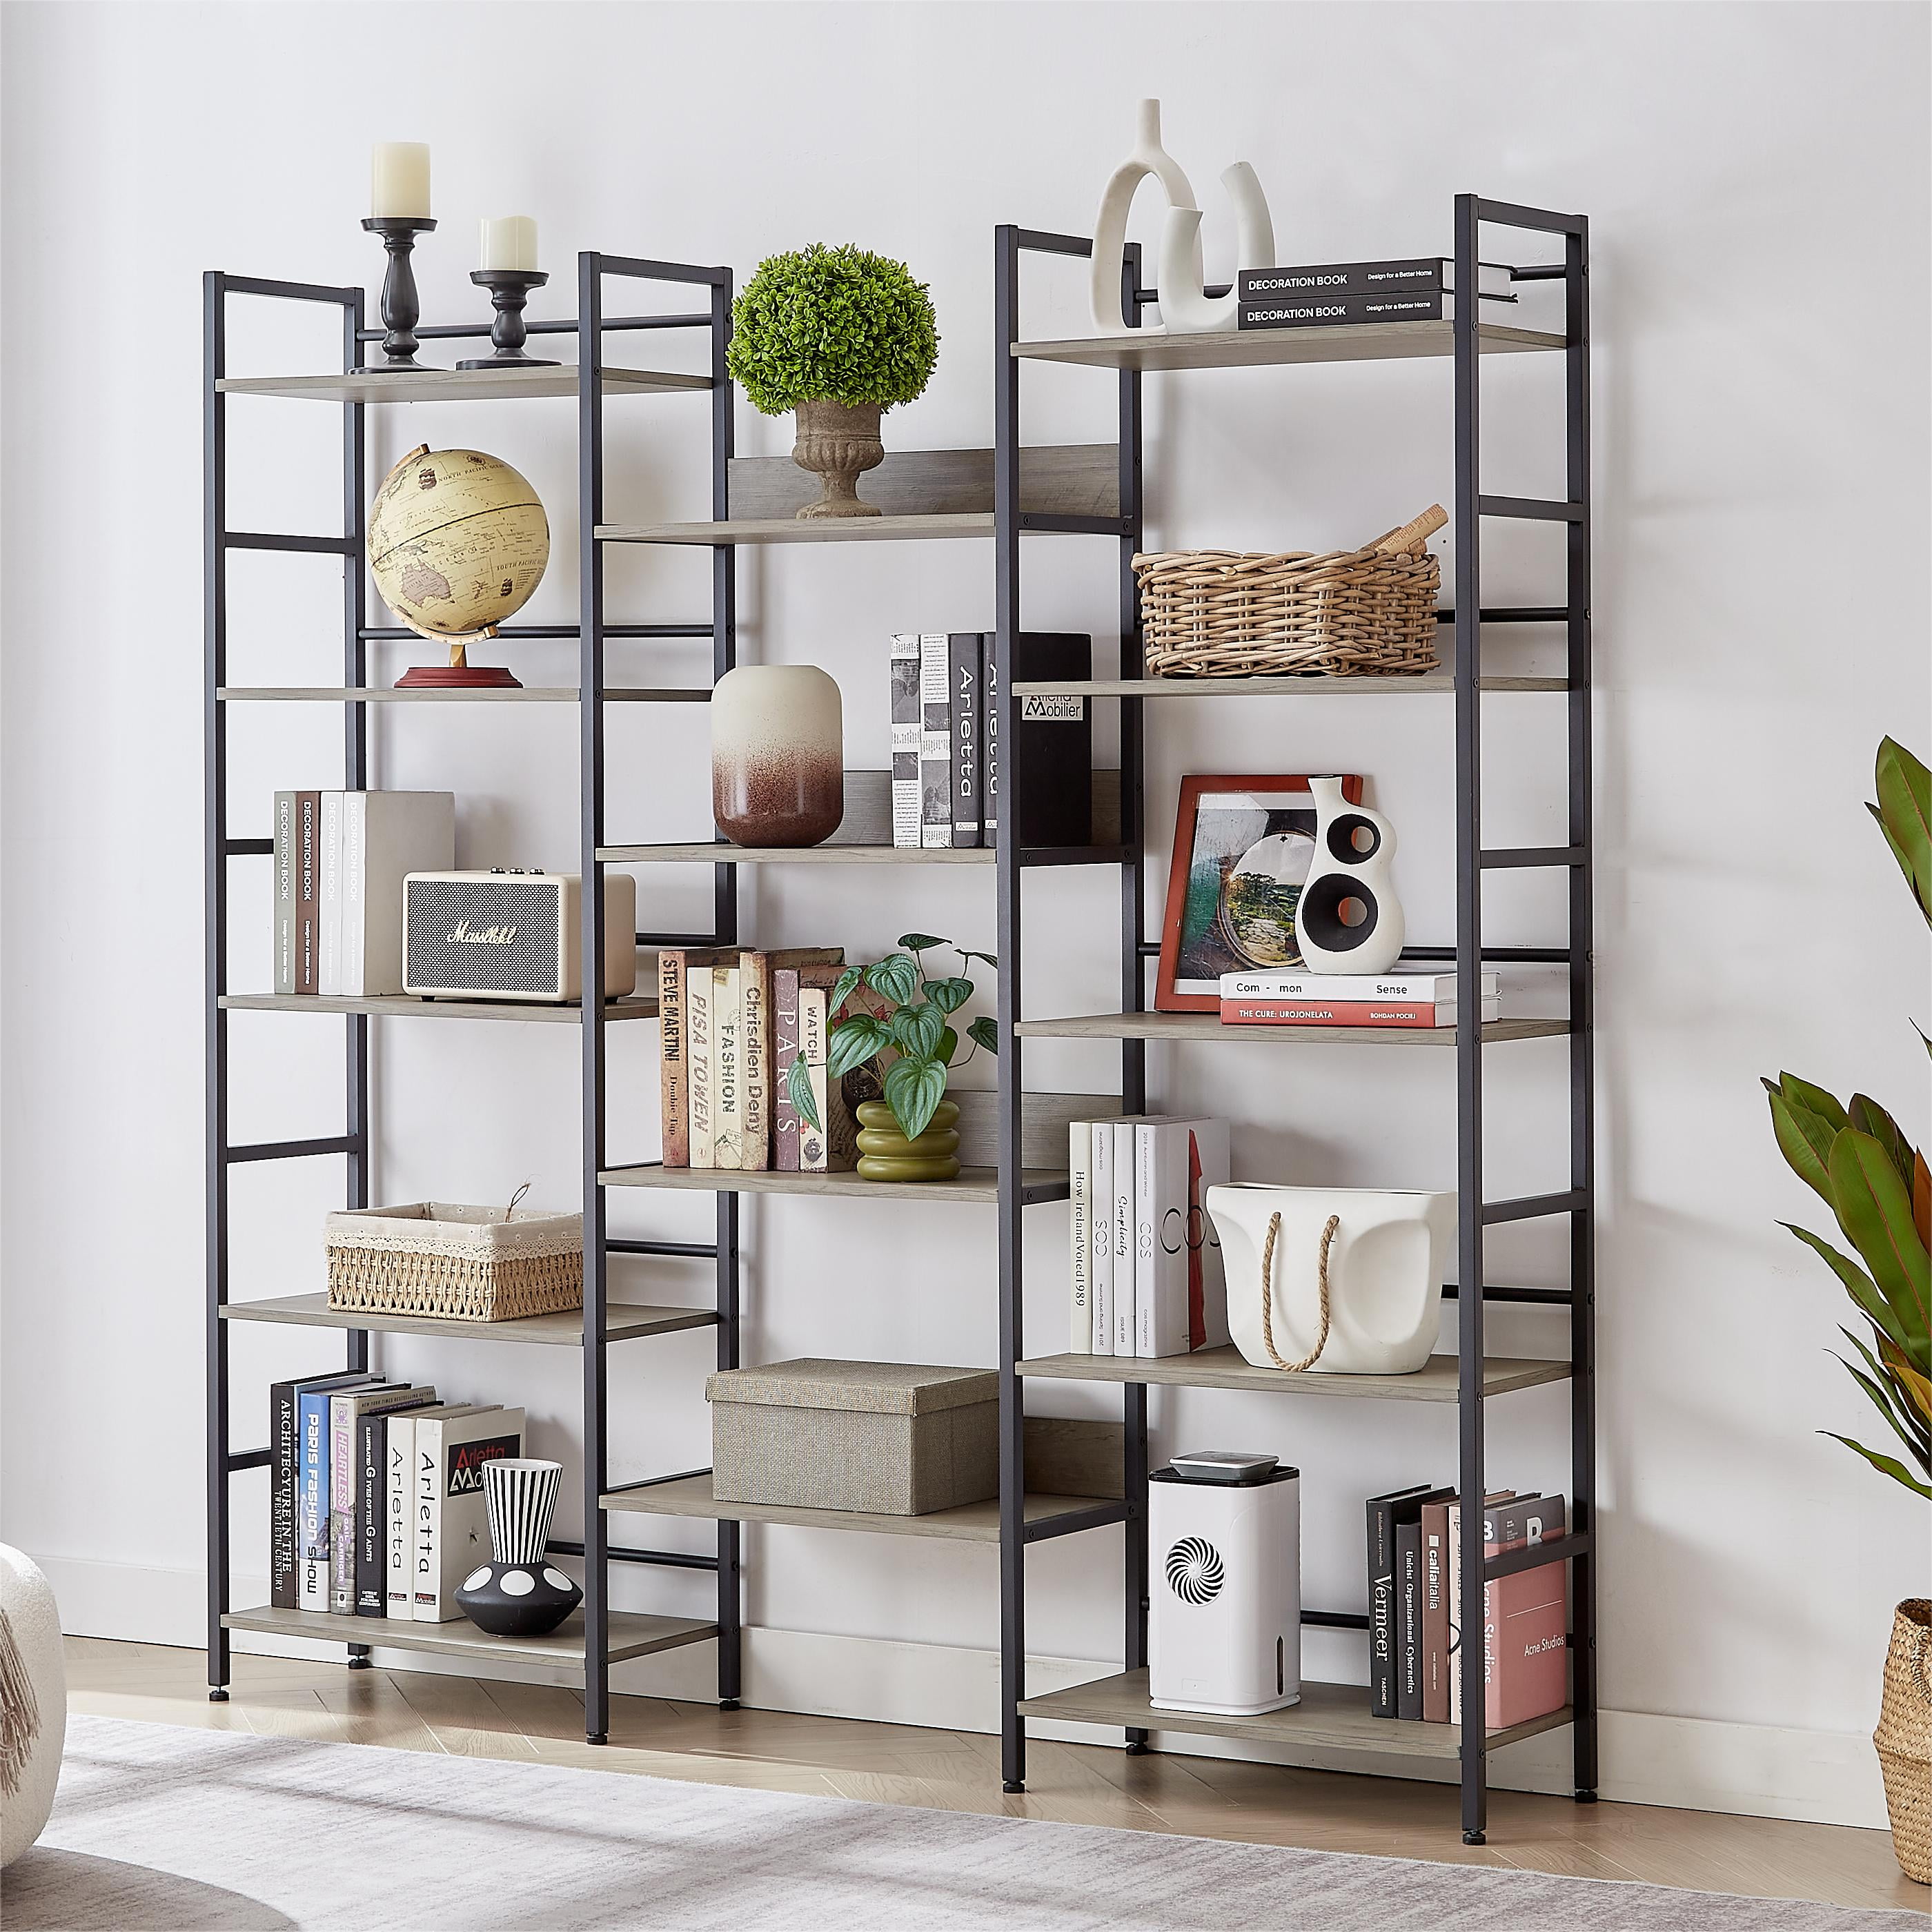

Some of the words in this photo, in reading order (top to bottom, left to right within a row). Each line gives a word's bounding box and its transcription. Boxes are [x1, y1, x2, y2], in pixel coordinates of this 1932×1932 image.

[1248, 276, 1315, 290] DECORATION
[1317, 274, 1348, 286] BOOK
[1247, 308, 1314, 322] DECORATION
[1315, 305, 1346, 317] BOOK
[960, 665, 974, 797] Arletta
[1025, 701, 1081, 717] Mobilier
[280, 801, 288, 868] DECORATION
[304, 801, 312, 869] DECORATION
[280, 869, 288, 900] BOOK
[304, 870, 312, 901] BOOK
[663, 959, 679, 1003] STEVE
[1236, 983, 1260, 992] Com
[1279, 985, 1303, 993] mon
[1377, 985, 1408, 994] Sense
[664, 1007, 680, 1061] MARTINI
[693, 993, 707, 1045] PISA
[747, 987, 762, 1078] Chrisdien
[807, 1006, 818, 1058] WATCH
[1239, 1009, 1253, 1018] THE
[1255, 1010, 1277, 1018] CURE:
[722, 1025, 735, 1112] FASHION
[694, 1054, 709, 1133] TOWEN
[746, 1085, 762, 1135] Deny
[669, 1116, 678, 1136] Tap
[1076, 1171, 1085, 1199] How
[1116, 1196, 1128, 1259] Simplicity
[1140, 1221, 1152, 1259] COS
[281, 1399, 292, 1518] ARCHITECYURE
[337, 1433, 348, 1510] HEARTLESS
[457, 1446, 504, 1468] Arletta
[282, 1520, 292, 1538] IN
[392, 1447, 403, 1568] Arletta
[419, 1452, 435, 1573] Arletta
[275, 1548, 283, 1592] CENTURY
[282, 1540, 292, 1573] THE
[308, 1546, 317, 1593] SHOW
[1429, 1550, 1441, 1610] caliaitalia
[1374, 1573, 1392, 1662] Vermeer
[1524, 1644, 1541, 1657] Acne
[1541, 1634, 1564, 1651] Studios
